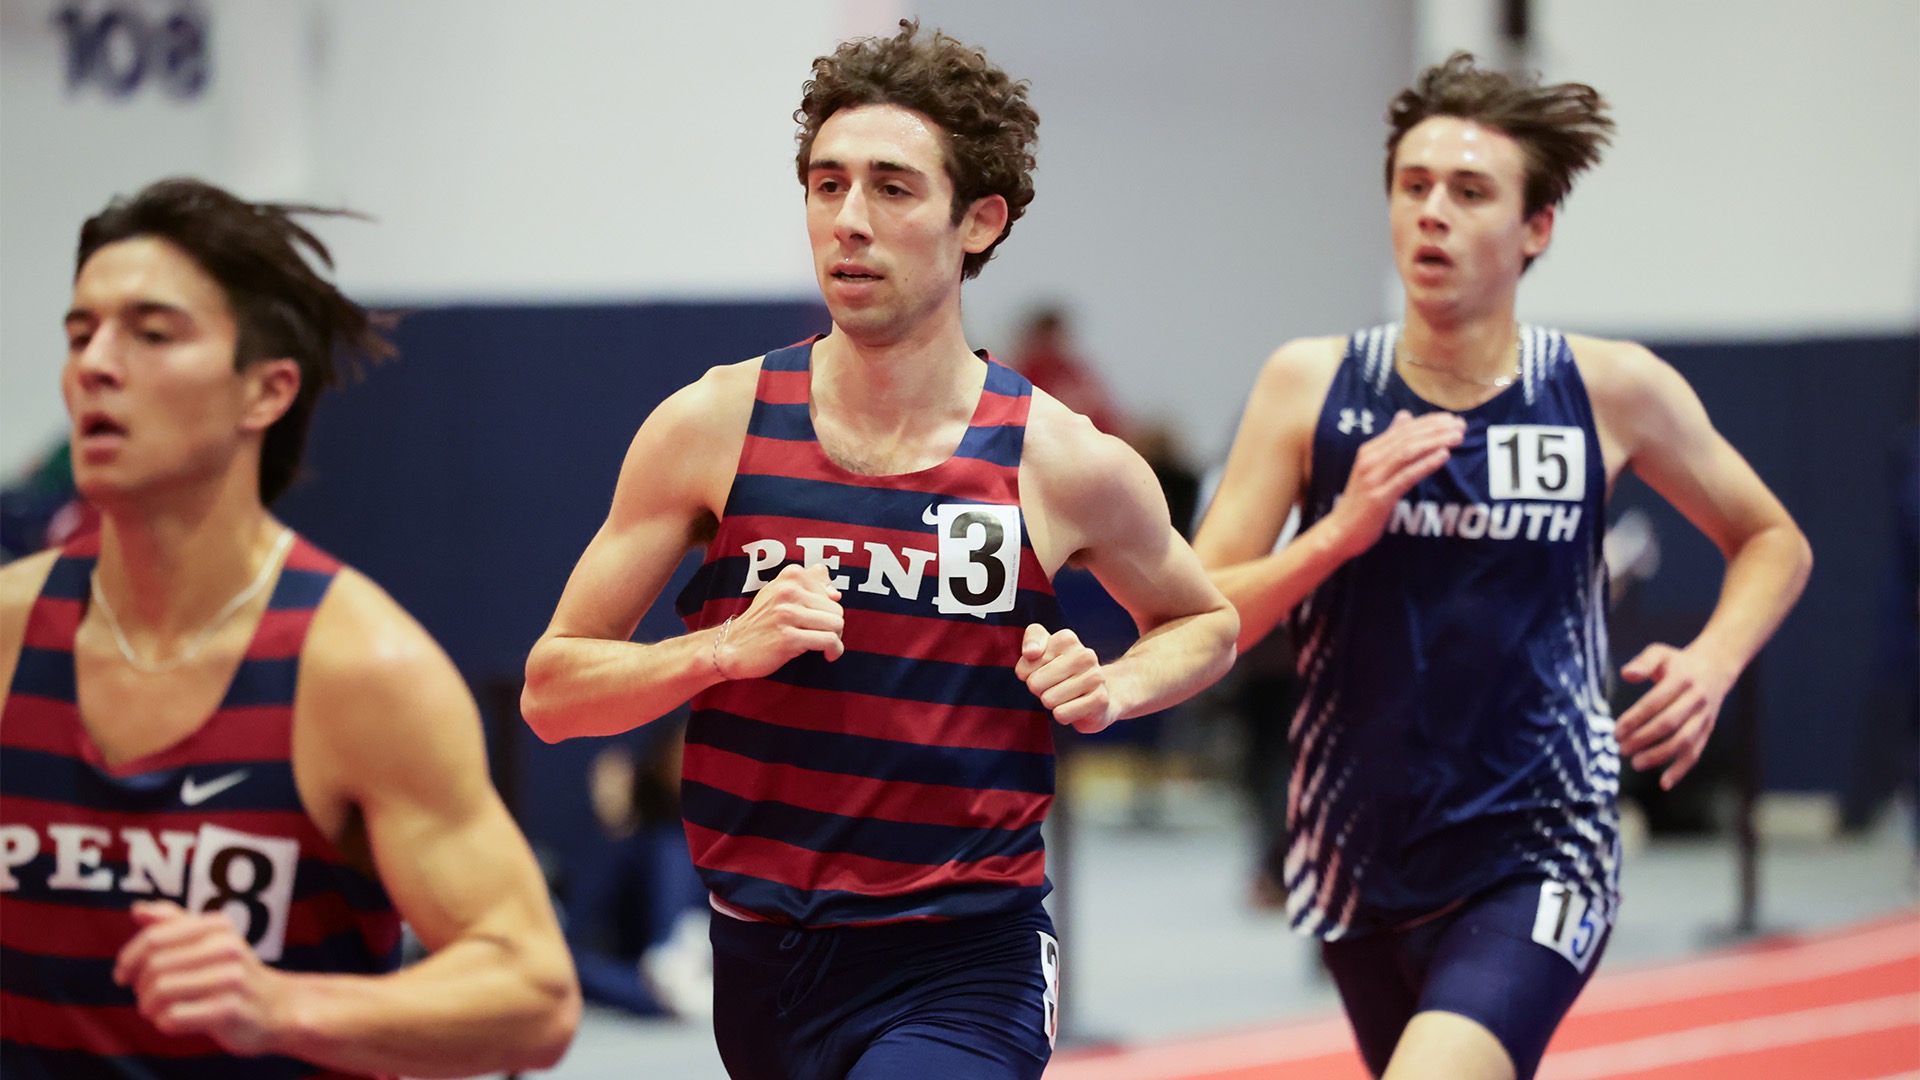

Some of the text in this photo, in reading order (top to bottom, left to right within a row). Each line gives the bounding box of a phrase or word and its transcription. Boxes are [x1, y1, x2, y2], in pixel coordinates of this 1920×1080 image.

[1497, 431, 1569, 492] 15
[1388, 500, 1582, 541] NMOUTH
[741, 537, 938, 605] PEN
[948, 510, 1006, 606] 3
[202, 846, 273, 947] 8
[1552, 888, 1596, 959] 15
